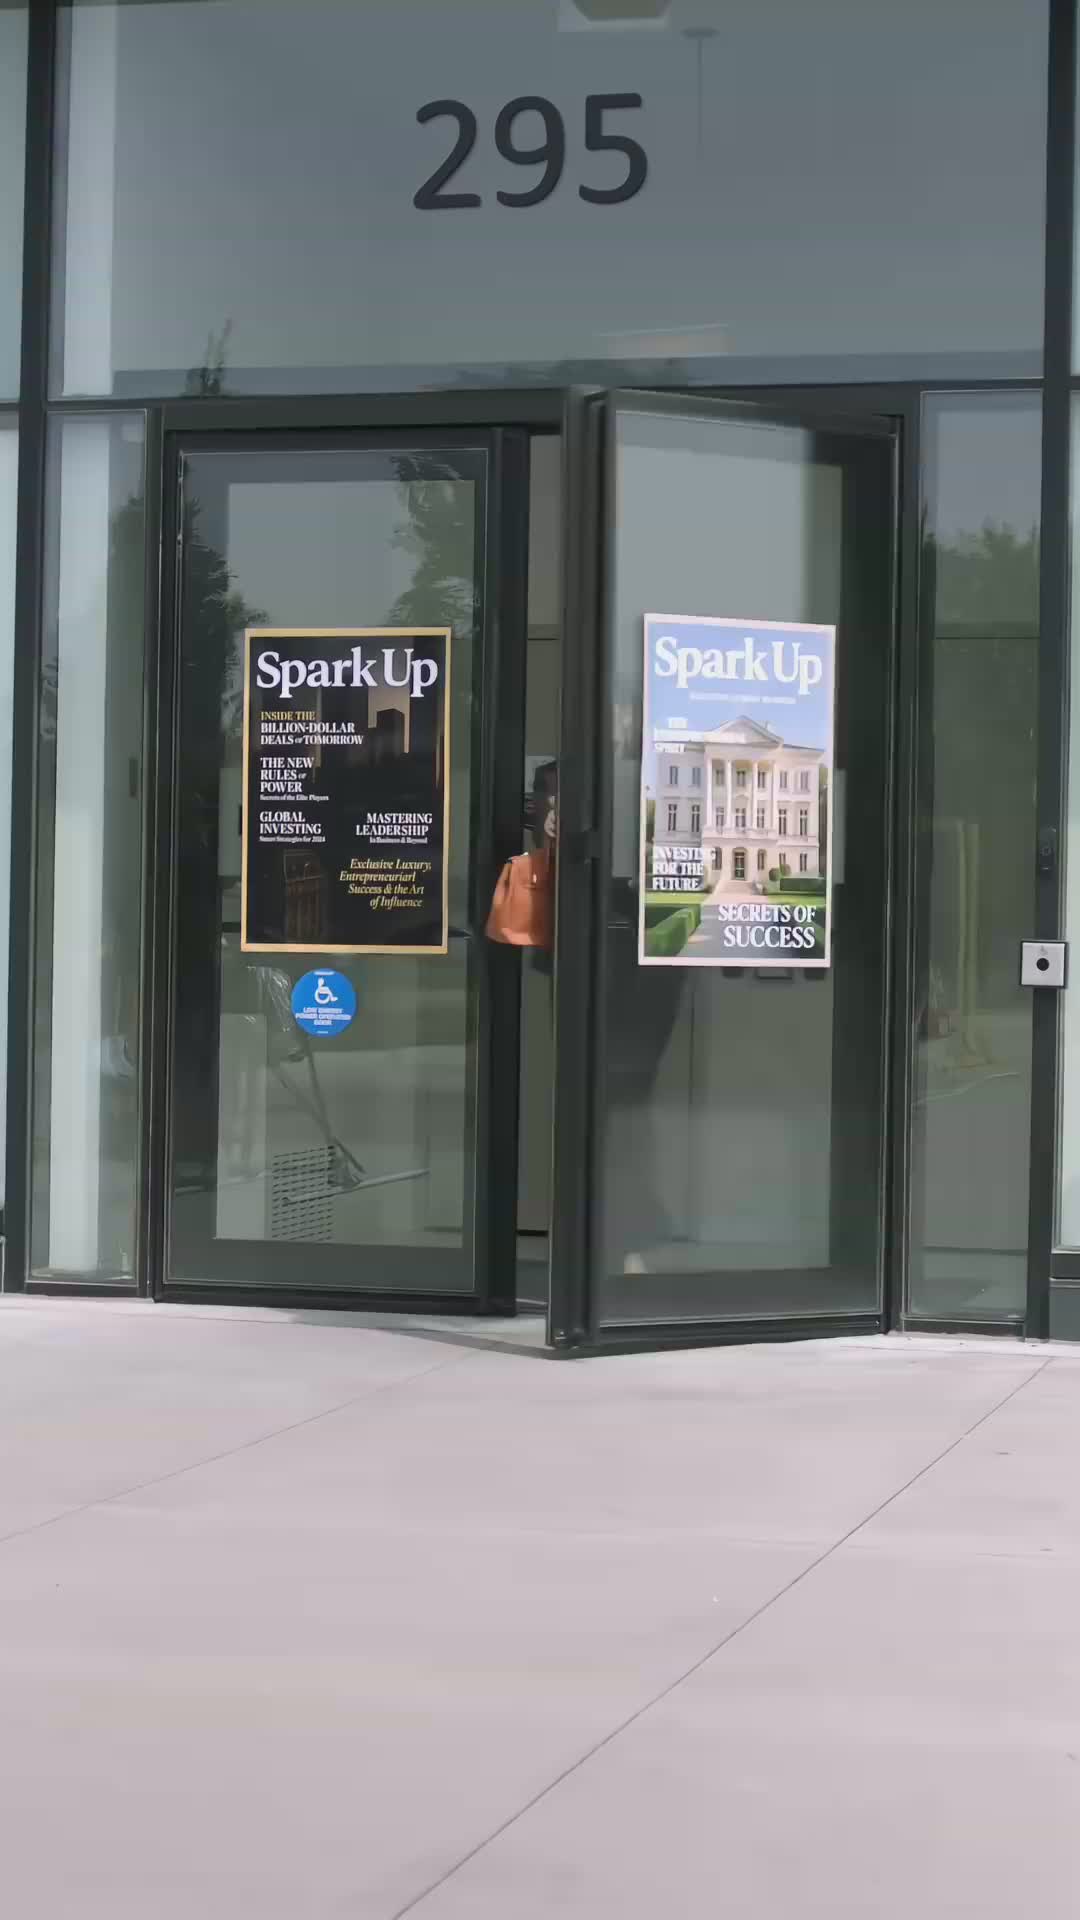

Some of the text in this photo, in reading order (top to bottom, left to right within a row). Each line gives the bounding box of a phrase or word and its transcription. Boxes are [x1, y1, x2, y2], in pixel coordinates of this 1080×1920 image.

[413, 92, 649, 210] 295
[654, 635, 823, 695] Spark Up
[256, 646, 438, 699] Spark Up
[261, 712, 316, 721] INSIDE THE
[260, 722, 355, 733] BILLION-DOLLAR
[260, 735, 294, 745] DEALS
[303, 735, 364, 745] TOMORROW
[260, 757, 315, 769] THE NEW
[260, 769, 297, 781] RULES
[260, 781, 303, 793] POWER
[260, 811, 306, 823] GLOBAL
[366, 812, 433, 824] MASTERING
[259, 823, 322, 835] INVESTING
[356, 824, 429, 836] LEADERSHIP
[350, 858, 394, 870] Exclusive
[652, 862, 704, 876] FOR THE
[348, 883, 425, 895] Success & the Art
[652, 877, 702, 891] FUTURE
[369, 895, 423, 910] of Influence
[718, 904, 817, 923] SECRETS OF
[723, 925, 816, 949] SUCCESS
